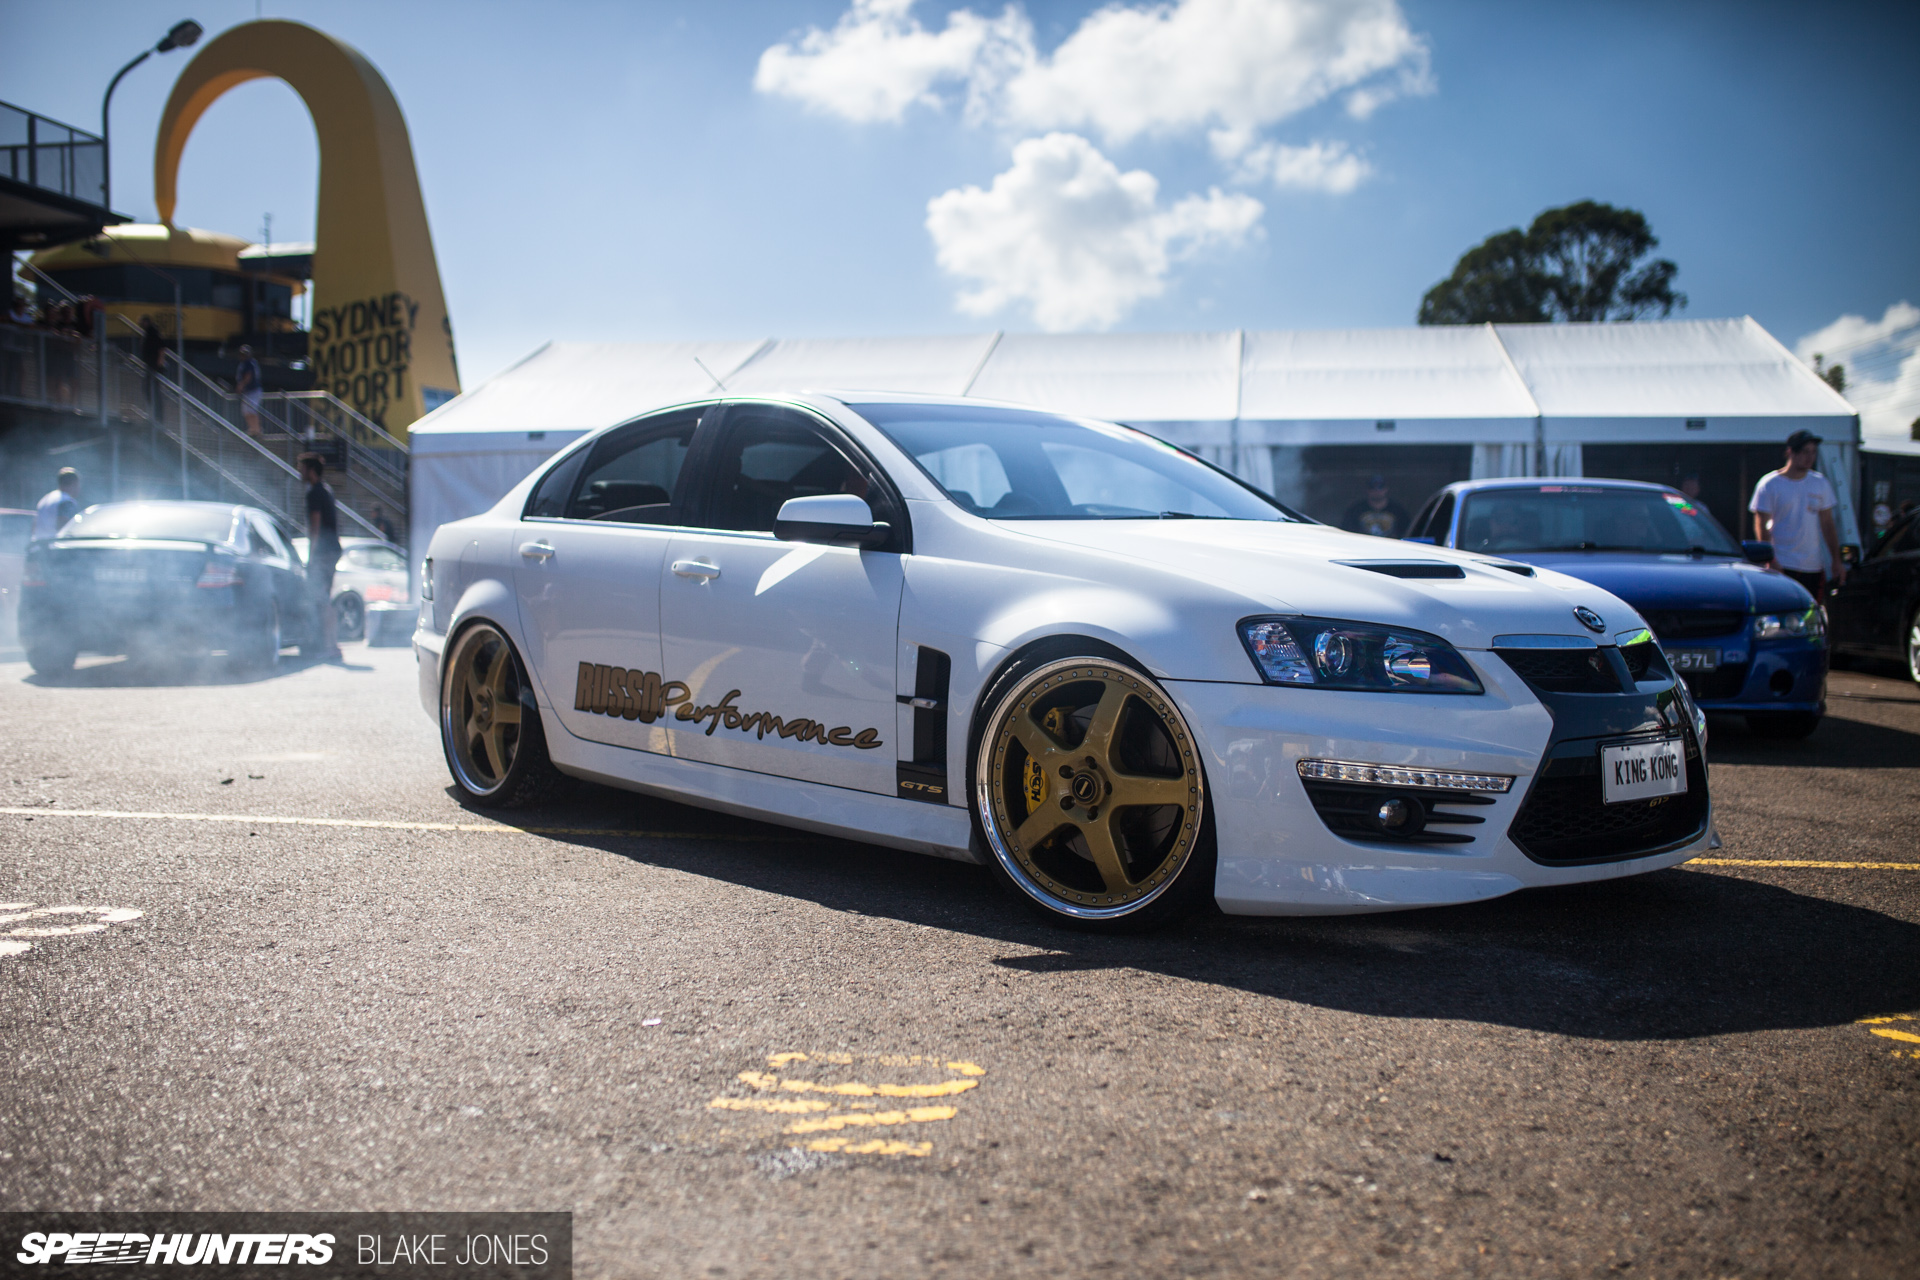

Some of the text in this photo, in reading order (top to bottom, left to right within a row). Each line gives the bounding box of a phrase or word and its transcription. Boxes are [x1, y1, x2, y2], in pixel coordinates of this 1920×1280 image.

[313, 291, 420, 344] SYDNEY
[313, 327, 413, 379] MOTOR
[314, 365, 408, 407] SPORT
[574, 661, 883, 749] RUSSO Performance
[900, 780, 944, 794] GTS
[1615, 753, 1679, 786] KING KONG
